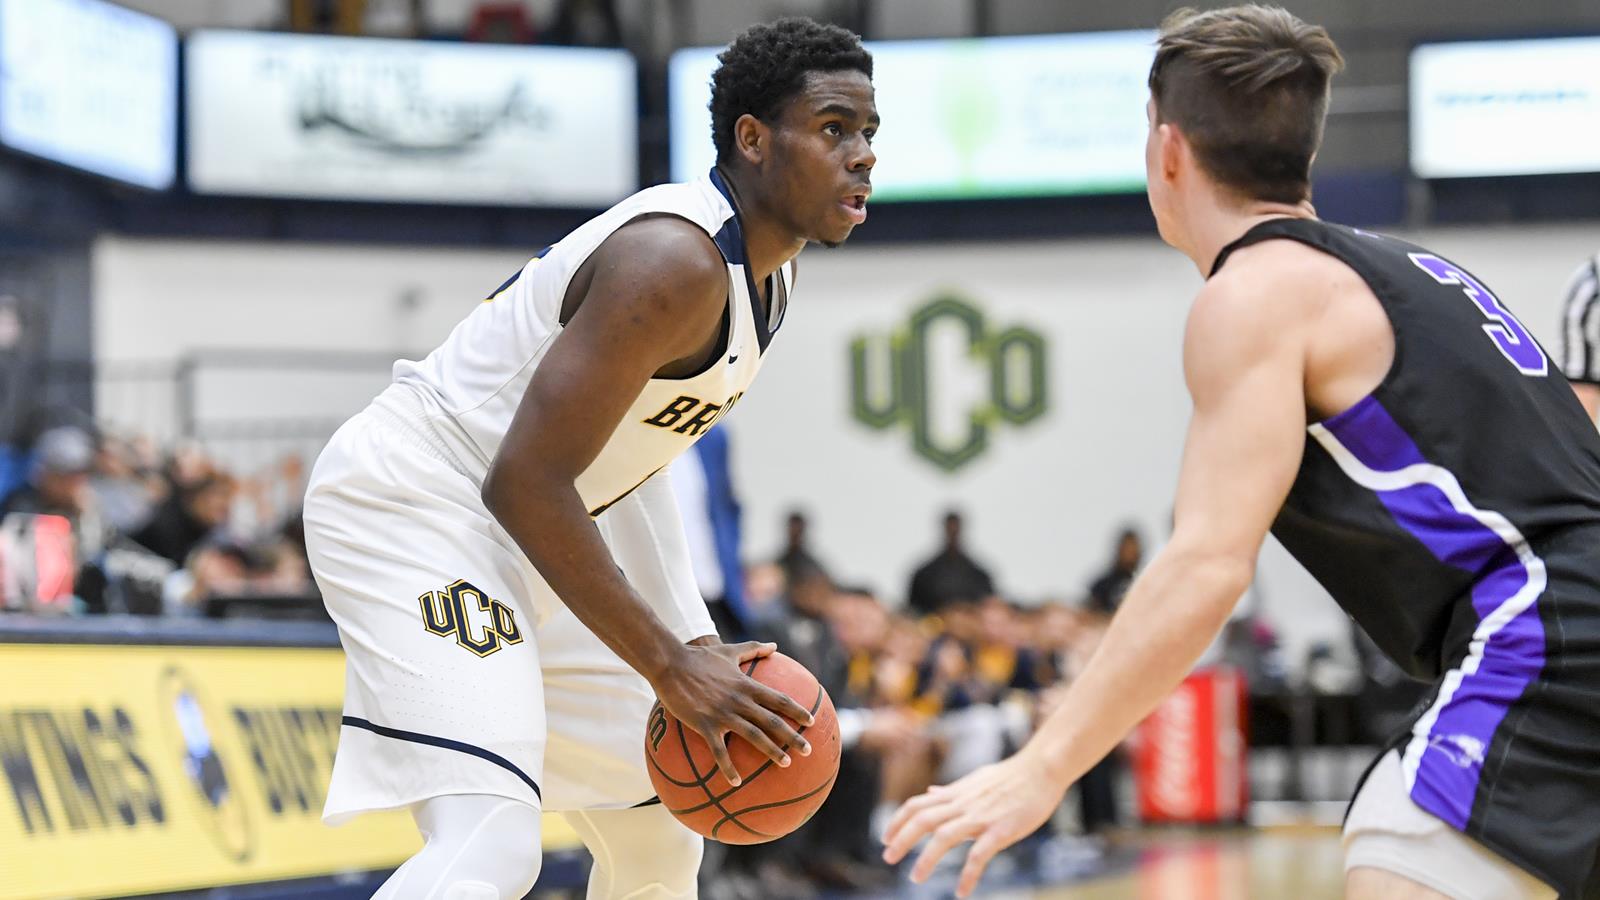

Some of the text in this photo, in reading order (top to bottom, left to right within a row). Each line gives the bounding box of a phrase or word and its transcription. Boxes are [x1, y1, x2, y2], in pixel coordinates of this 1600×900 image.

[1408, 252, 1549, 377] 3
[849, 294, 1050, 473] UCO
[418, 579, 524, 658] UCO
[0, 706, 167, 834] WINGS
